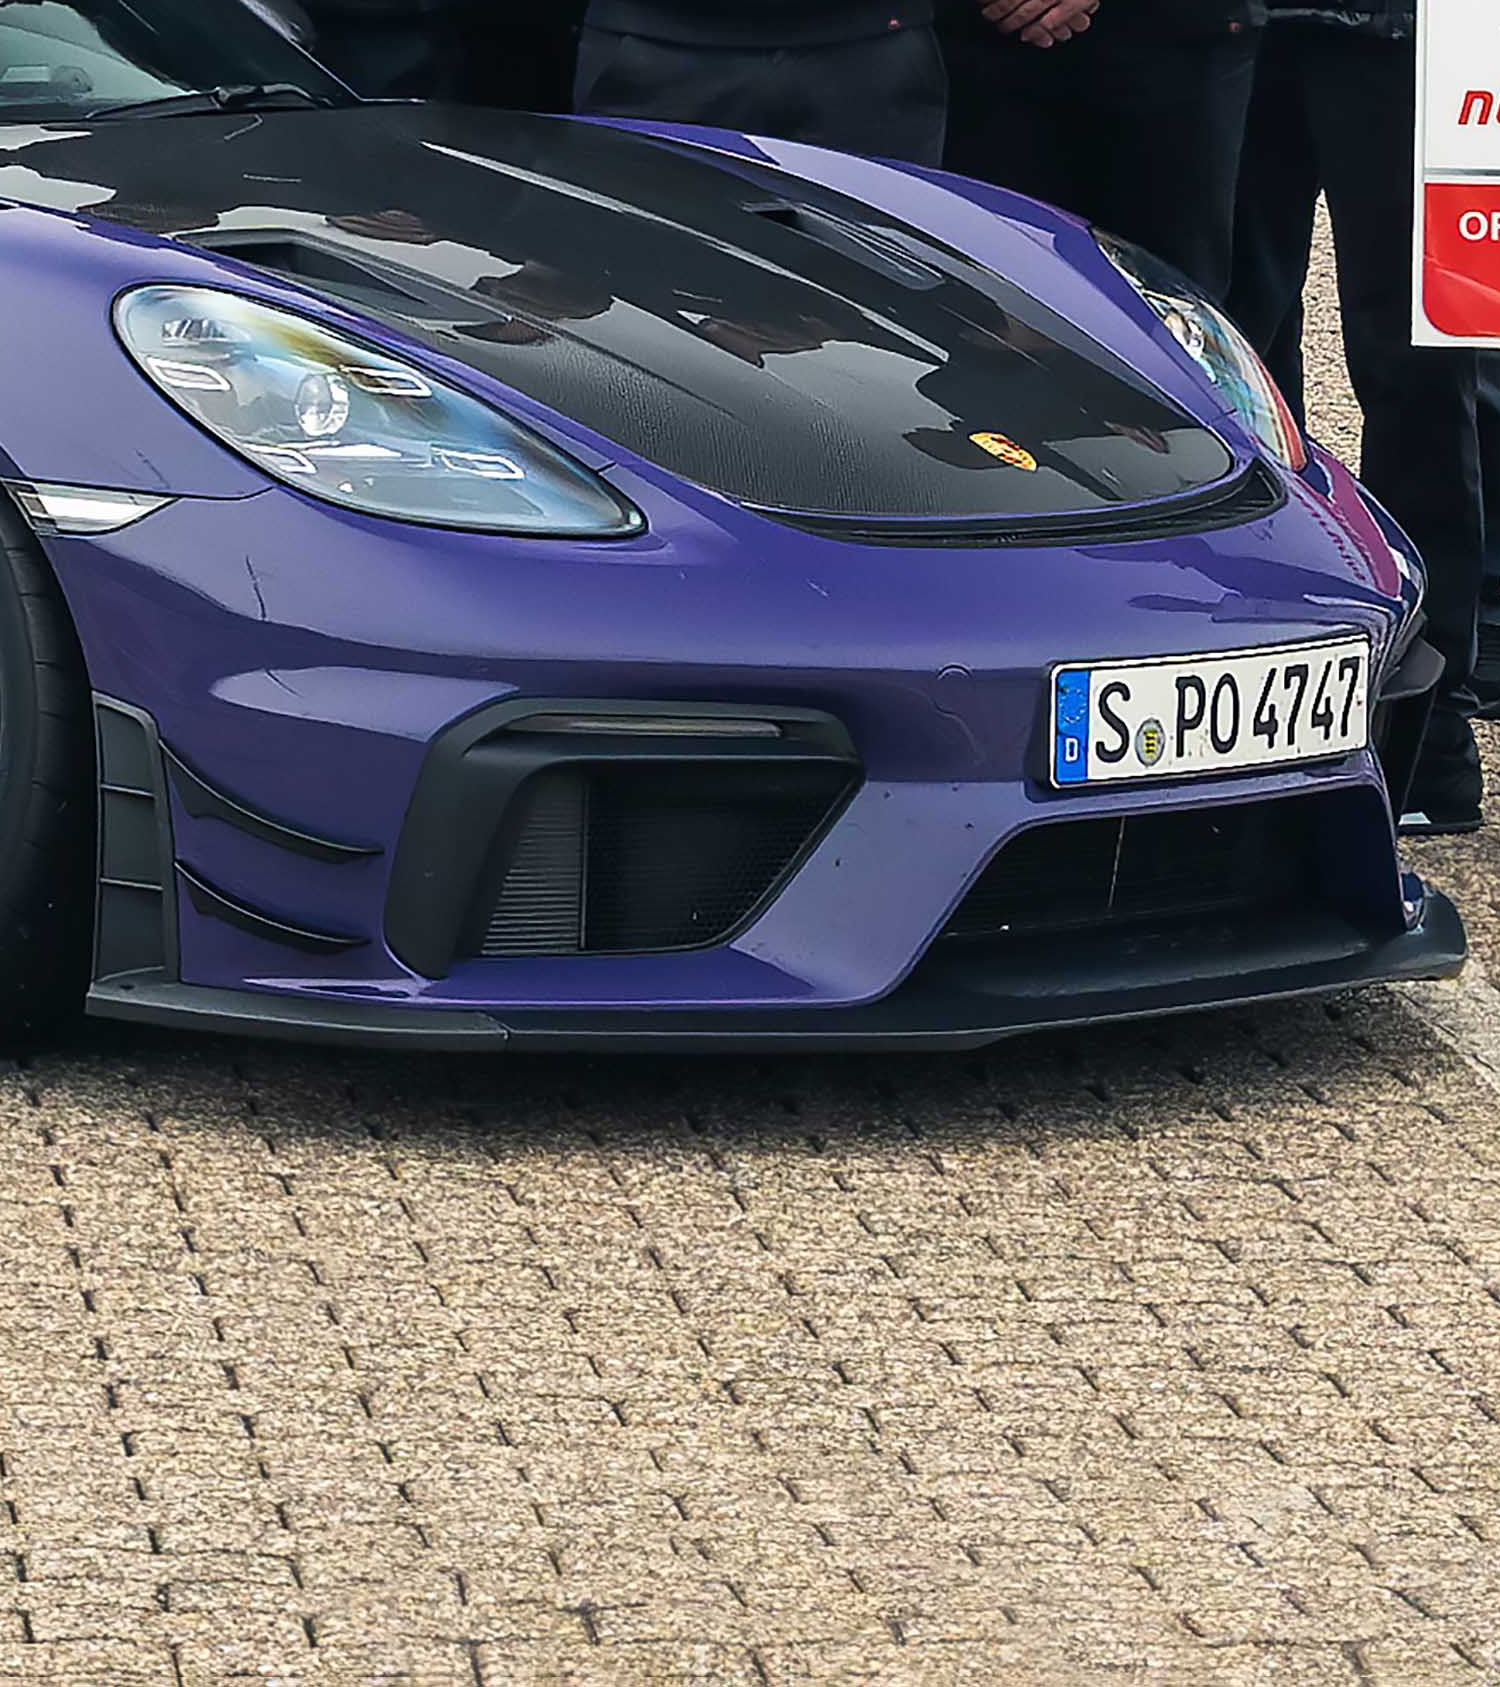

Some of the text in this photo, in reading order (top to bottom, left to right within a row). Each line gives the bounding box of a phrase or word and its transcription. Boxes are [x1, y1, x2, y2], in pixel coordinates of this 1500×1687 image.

[1095, 656, 1361, 763] S PO 4747
[1064, 736, 1079, 762] D
